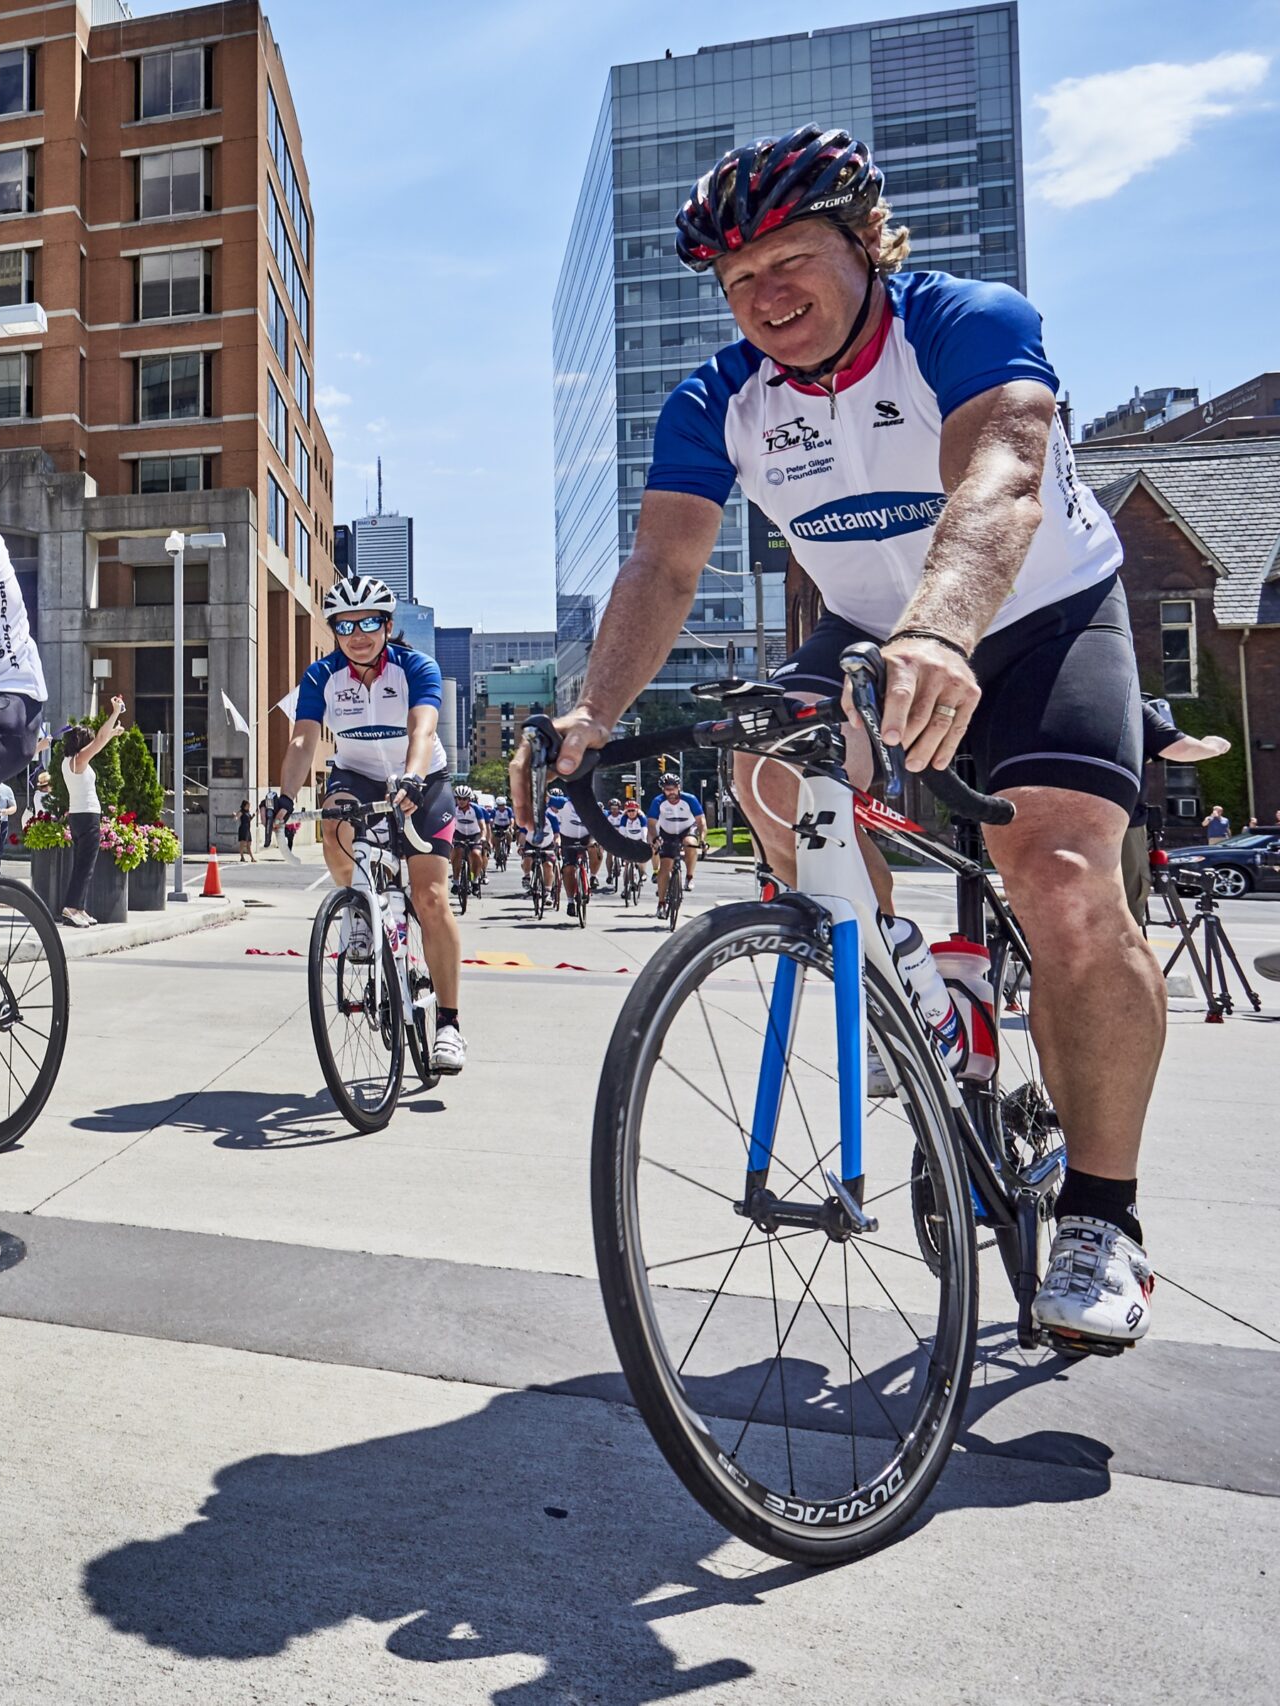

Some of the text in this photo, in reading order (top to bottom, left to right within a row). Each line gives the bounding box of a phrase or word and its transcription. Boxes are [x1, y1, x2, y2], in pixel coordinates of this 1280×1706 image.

[825, 194, 853, 208] GIRO
[786, 463, 807, 474] Peter
[787, 465, 832, 482] Foundation
[763, 1466, 905, 1525] DURA-ACE
